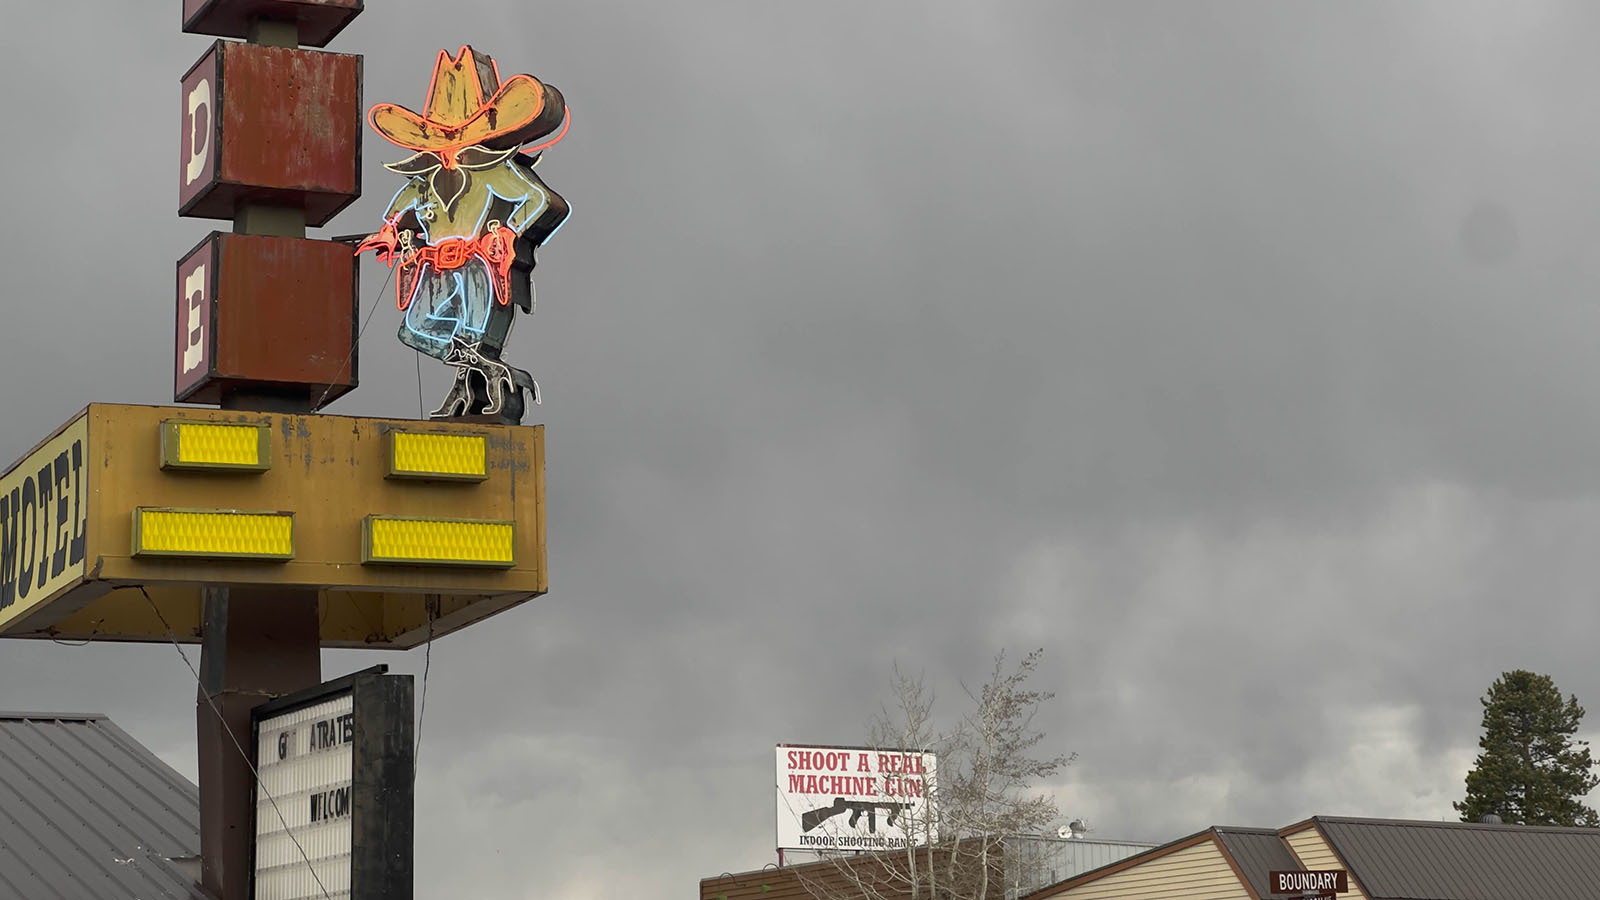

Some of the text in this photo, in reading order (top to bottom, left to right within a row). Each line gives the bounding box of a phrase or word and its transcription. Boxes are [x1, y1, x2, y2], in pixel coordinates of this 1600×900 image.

[0, 439, 87, 611] MOTEL
[787, 750, 927, 775] SHOOT A REAL
[788, 774, 879, 796] MACHINE
[799, 835, 835, 846] INDOOR
[838, 836, 885, 848] SHOOTING
[1279, 872, 1338, 891] BOUNDARY
